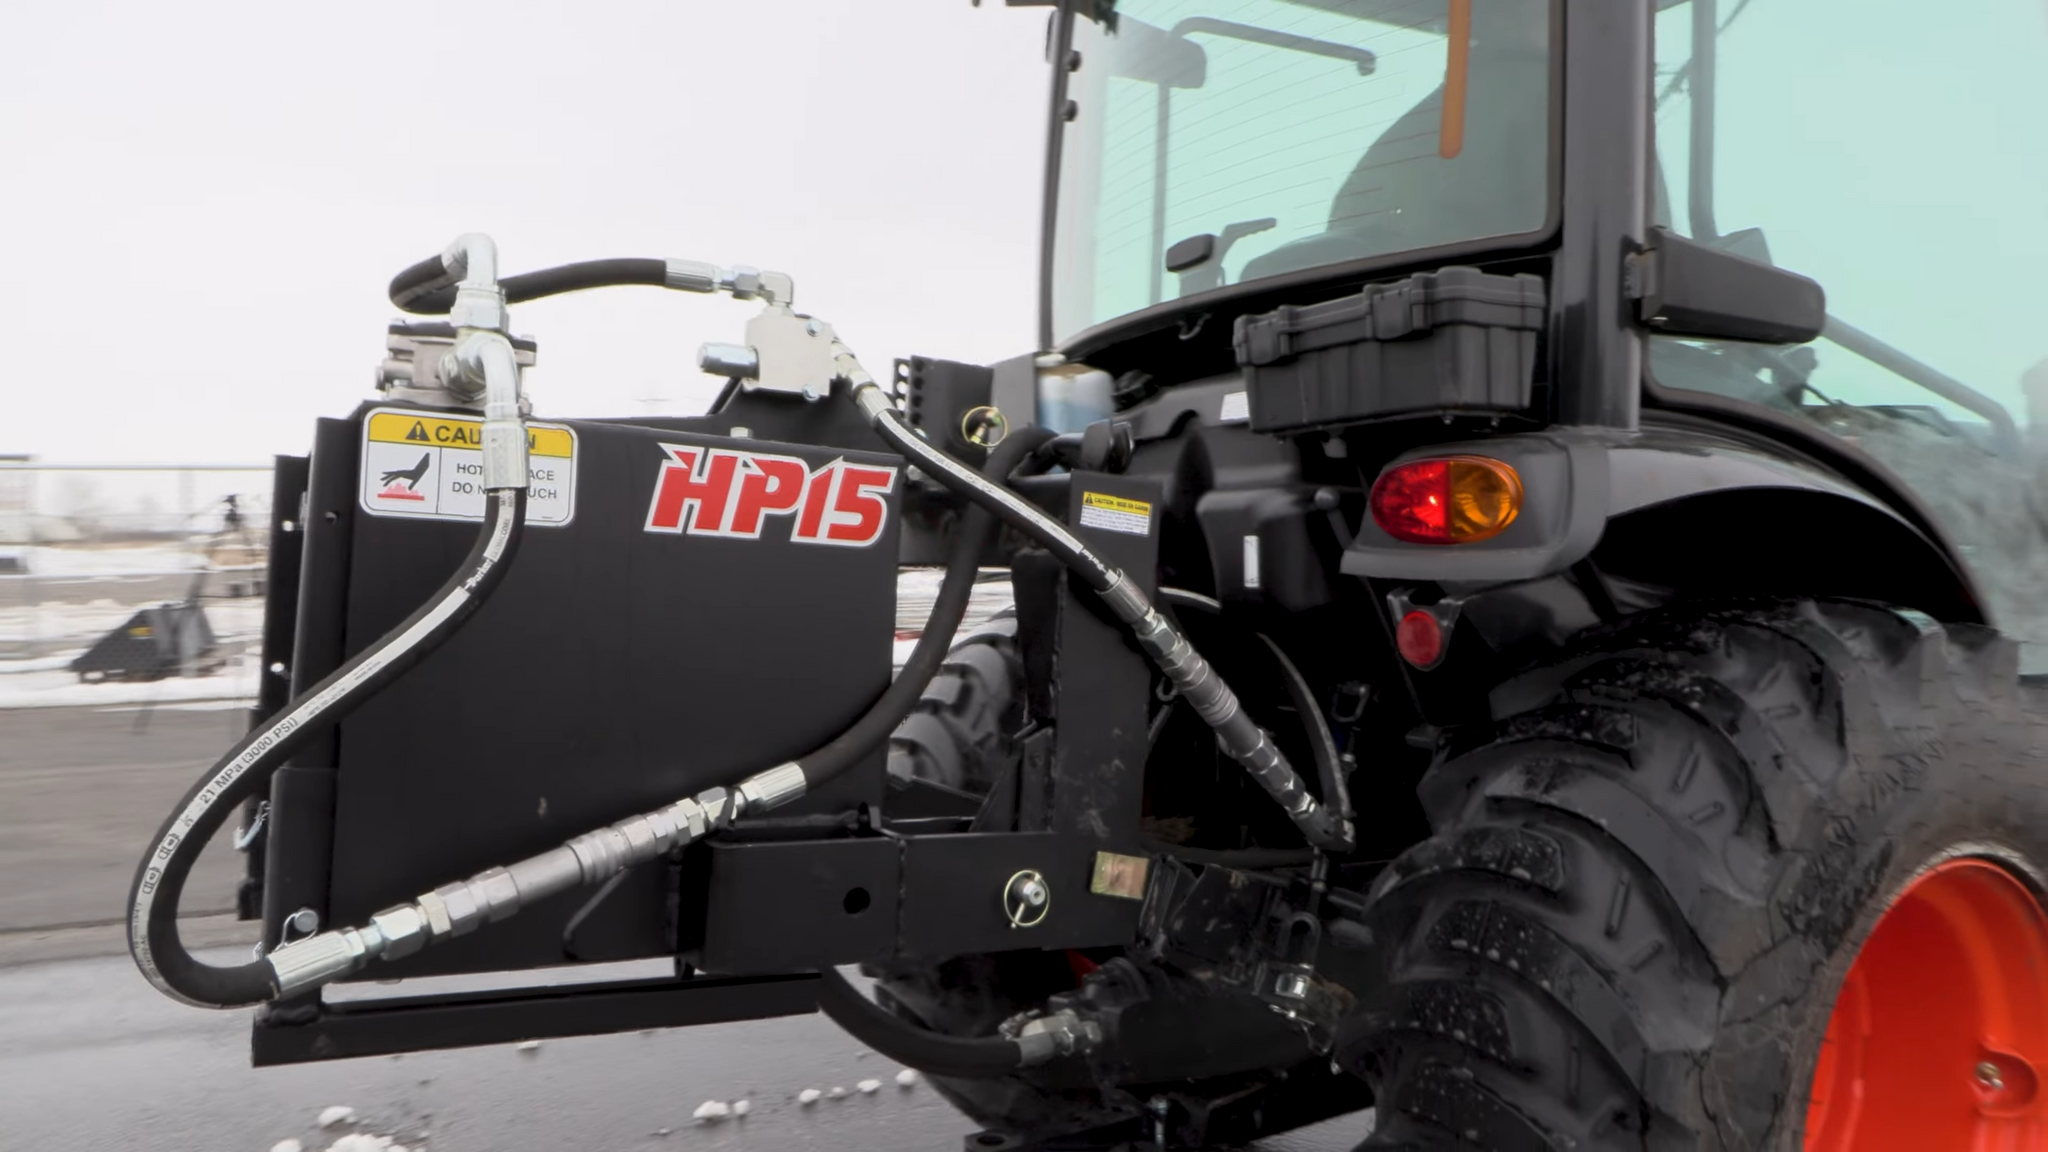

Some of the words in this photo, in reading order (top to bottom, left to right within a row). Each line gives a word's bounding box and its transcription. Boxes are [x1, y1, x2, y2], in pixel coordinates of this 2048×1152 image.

[452, 481, 473, 494] DO
[644, 442, 897, 547] HP15
[200, 788, 216, 804] 21
[214, 763, 244, 788] MPa
[241, 736, 273, 765] (3000
[273, 717, 299, 739] PSI)
